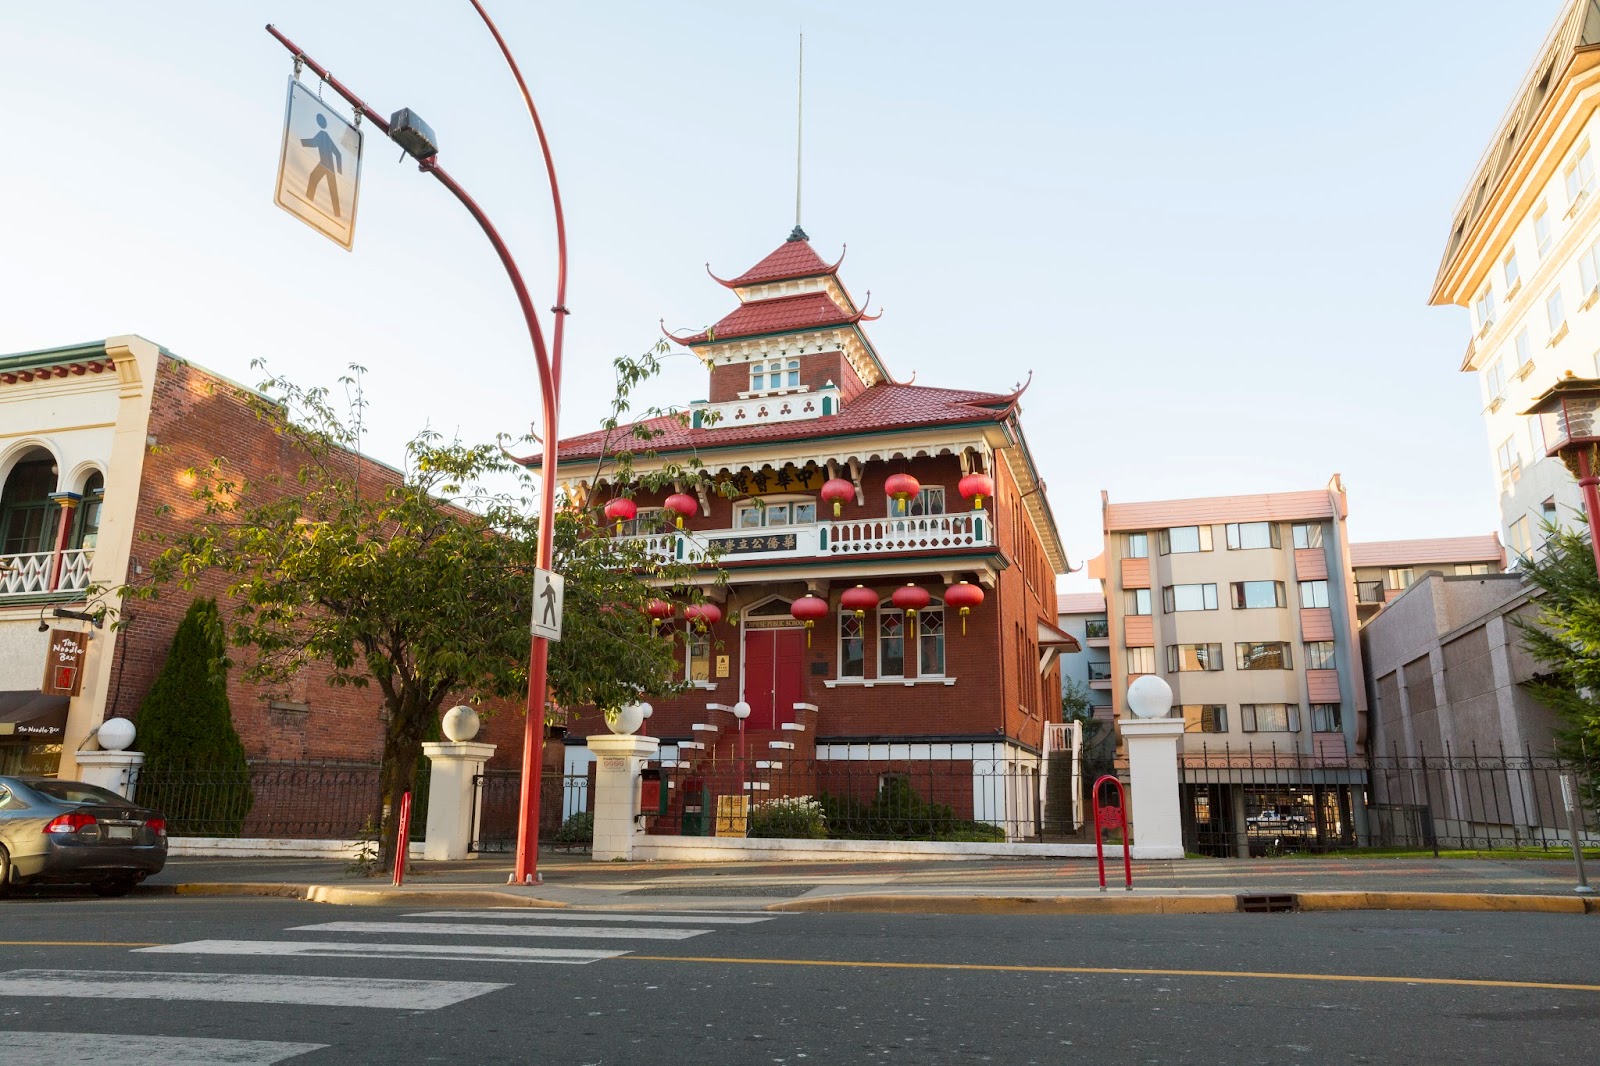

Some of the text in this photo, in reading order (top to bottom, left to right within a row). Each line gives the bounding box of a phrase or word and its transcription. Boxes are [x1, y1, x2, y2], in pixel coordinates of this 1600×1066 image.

[62, 638, 77, 647] The
[53, 644, 84, 654] Noodle
[59, 653, 75, 662] Box
[28, 726, 49, 734] Noodle
[49, 726, 60, 734] Box
